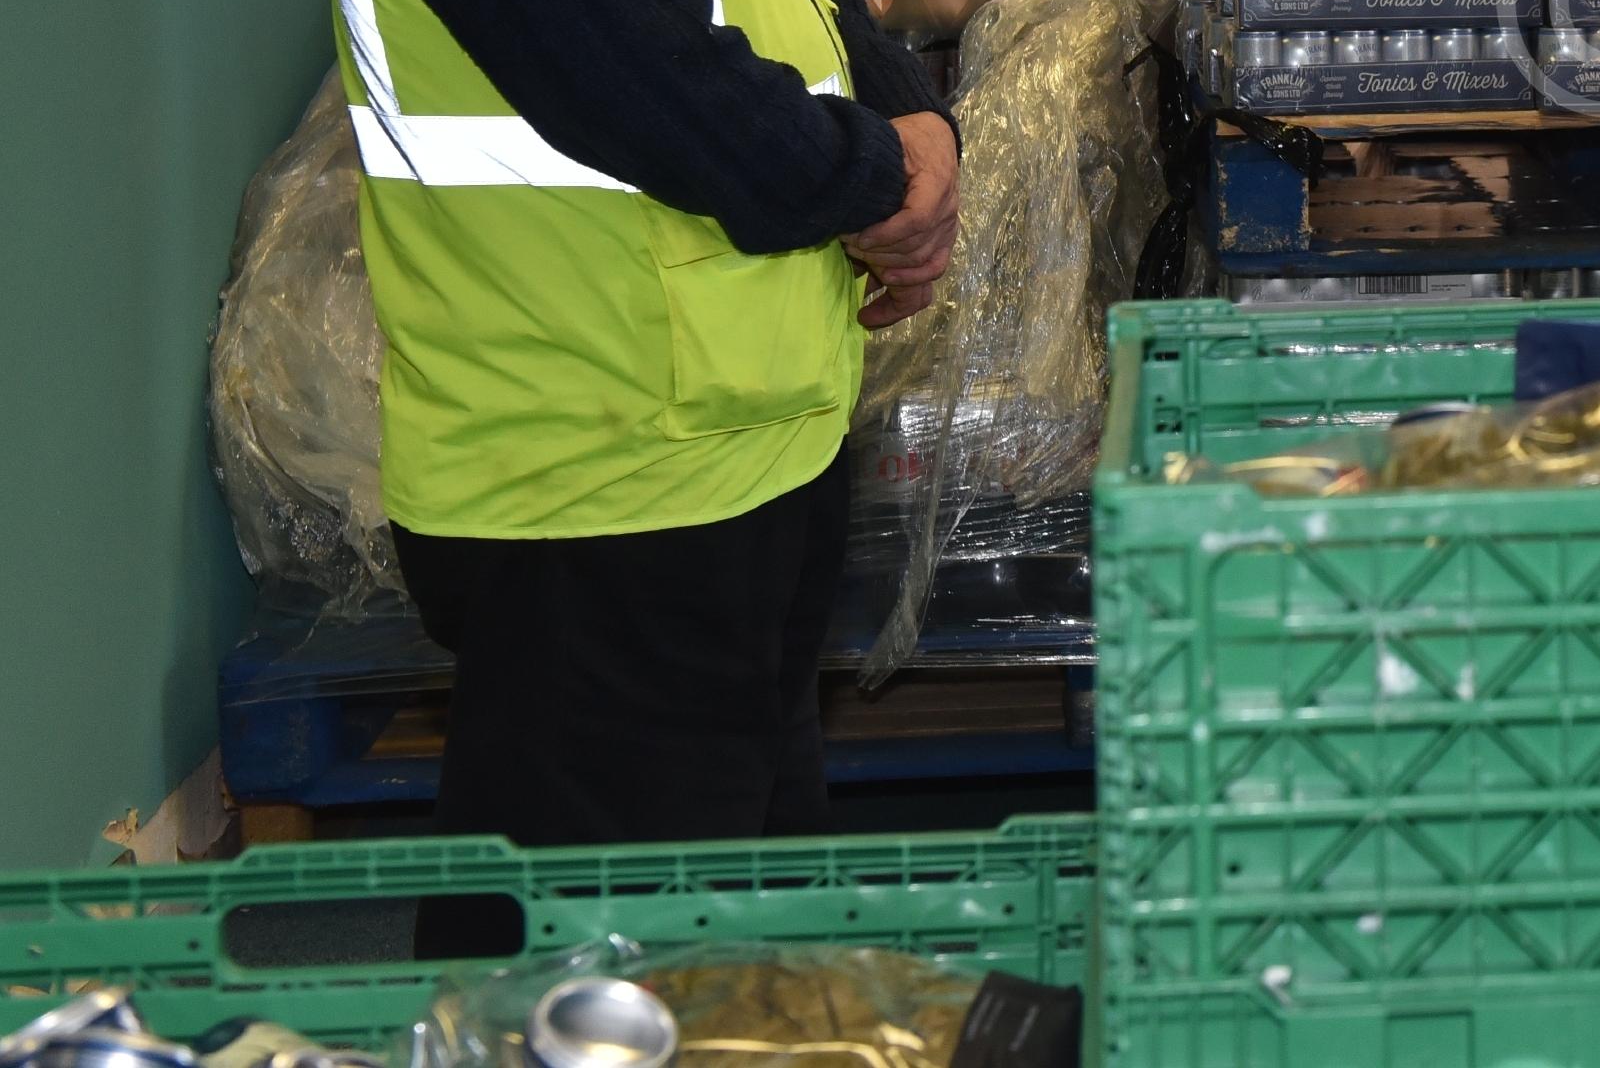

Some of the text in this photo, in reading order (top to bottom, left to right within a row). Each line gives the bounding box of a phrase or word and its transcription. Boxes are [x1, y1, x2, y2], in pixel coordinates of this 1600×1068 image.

[1280, 2, 1297, 11] SONS
[1297, 2, 1309, 10] LTD
[1260, 73, 1306, 89] FRANKLIN
[1357, 72, 1419, 93] Tonics
[1422, 71, 1439, 91] &
[1442, 70, 1508, 90] Mixers
